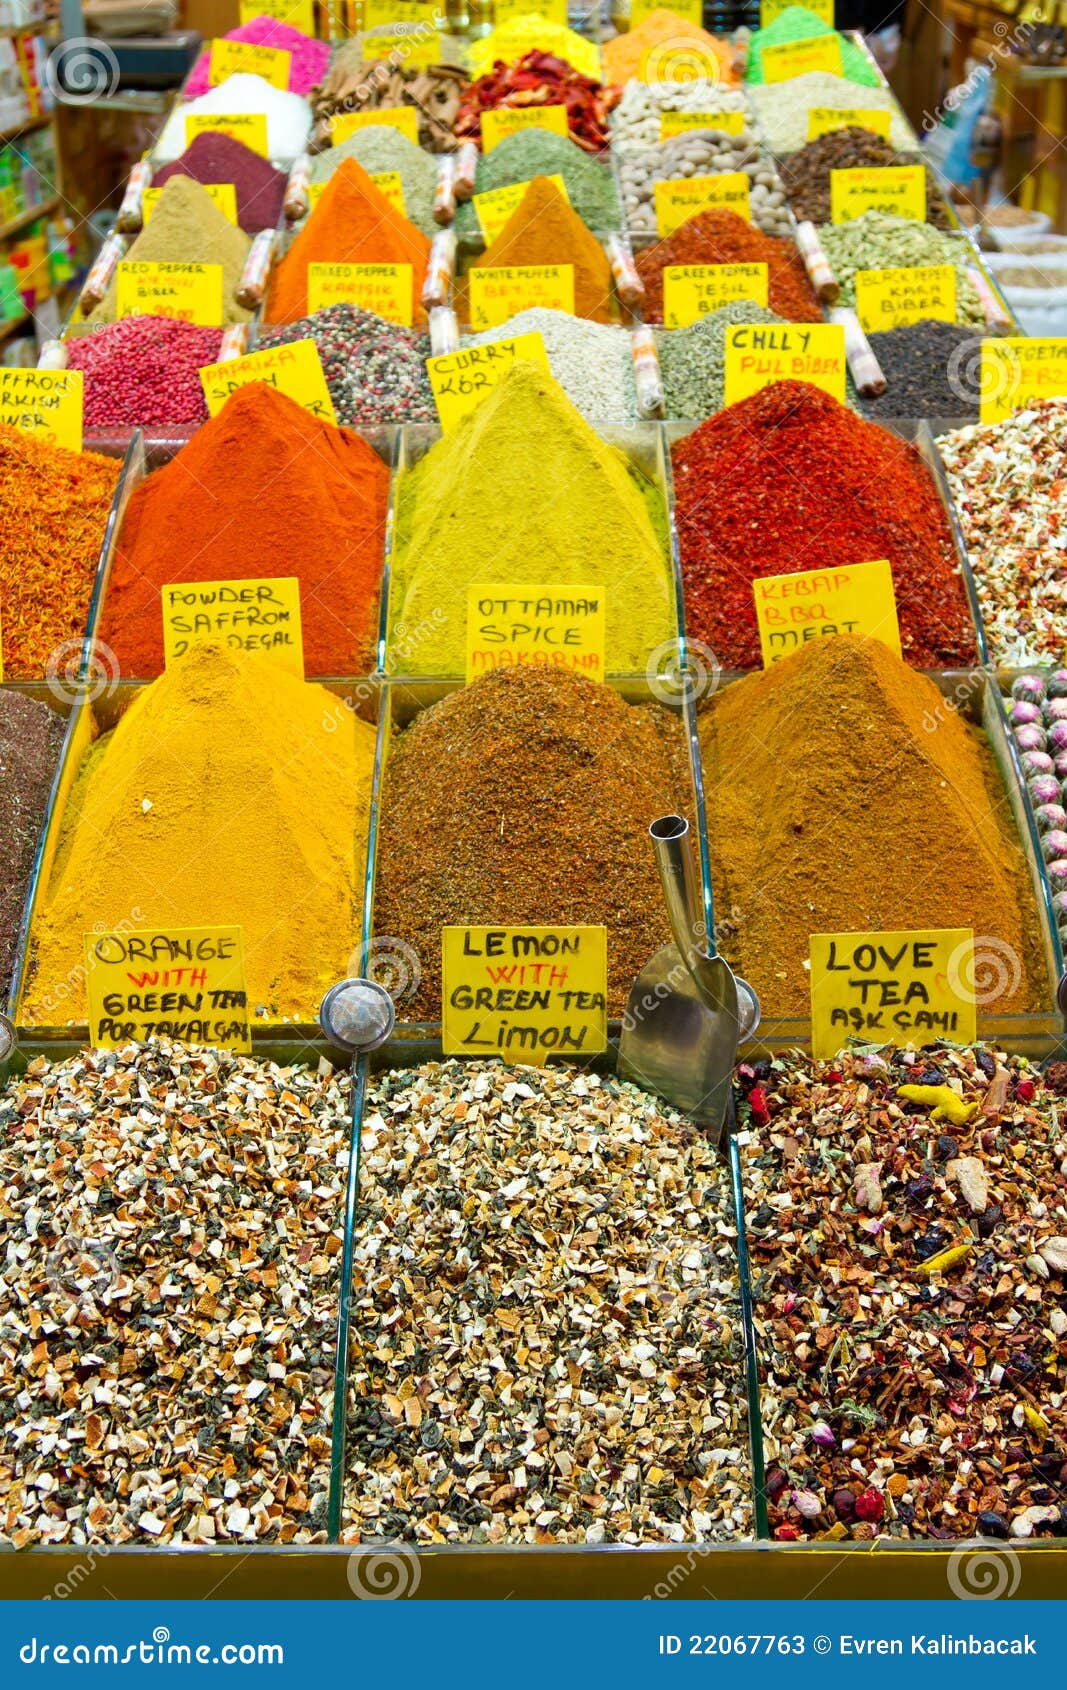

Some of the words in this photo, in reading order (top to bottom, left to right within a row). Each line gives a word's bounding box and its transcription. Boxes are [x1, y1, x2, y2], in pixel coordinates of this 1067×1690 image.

[121, 263, 149, 274] RED
[356, 266, 399, 277] PEPPER
[668, 267, 716, 281] GREEN
[732, 328, 811, 353] CHLLY
[434, 343, 517, 374] CURRY
[740, 355, 784, 375] PUL
[212, 372, 278, 399] SPY
[169, 585, 285, 607] POWDER
[761, 573, 851, 600] KEBAP
[764, 603, 833, 627] BBQ
[479, 623, 584, 646] SPICE
[769, 620, 860, 648] MEAT
[471, 649, 600, 672] MAKARNA
[95, 934, 237, 964] ORANGE
[463, 930, 581, 958] LEMON
[826, 940, 939, 973] LOVE
[126, 966, 208, 989] WITH
[485, 963, 569, 989] WITH
[102, 991, 204, 1017] GREEN
[207, 989, 248, 1010] TEA
[450, 984, 551, 1012] GREEN
[557, 990, 606, 1012] TEA
[848, 978, 930, 1007] TEA
